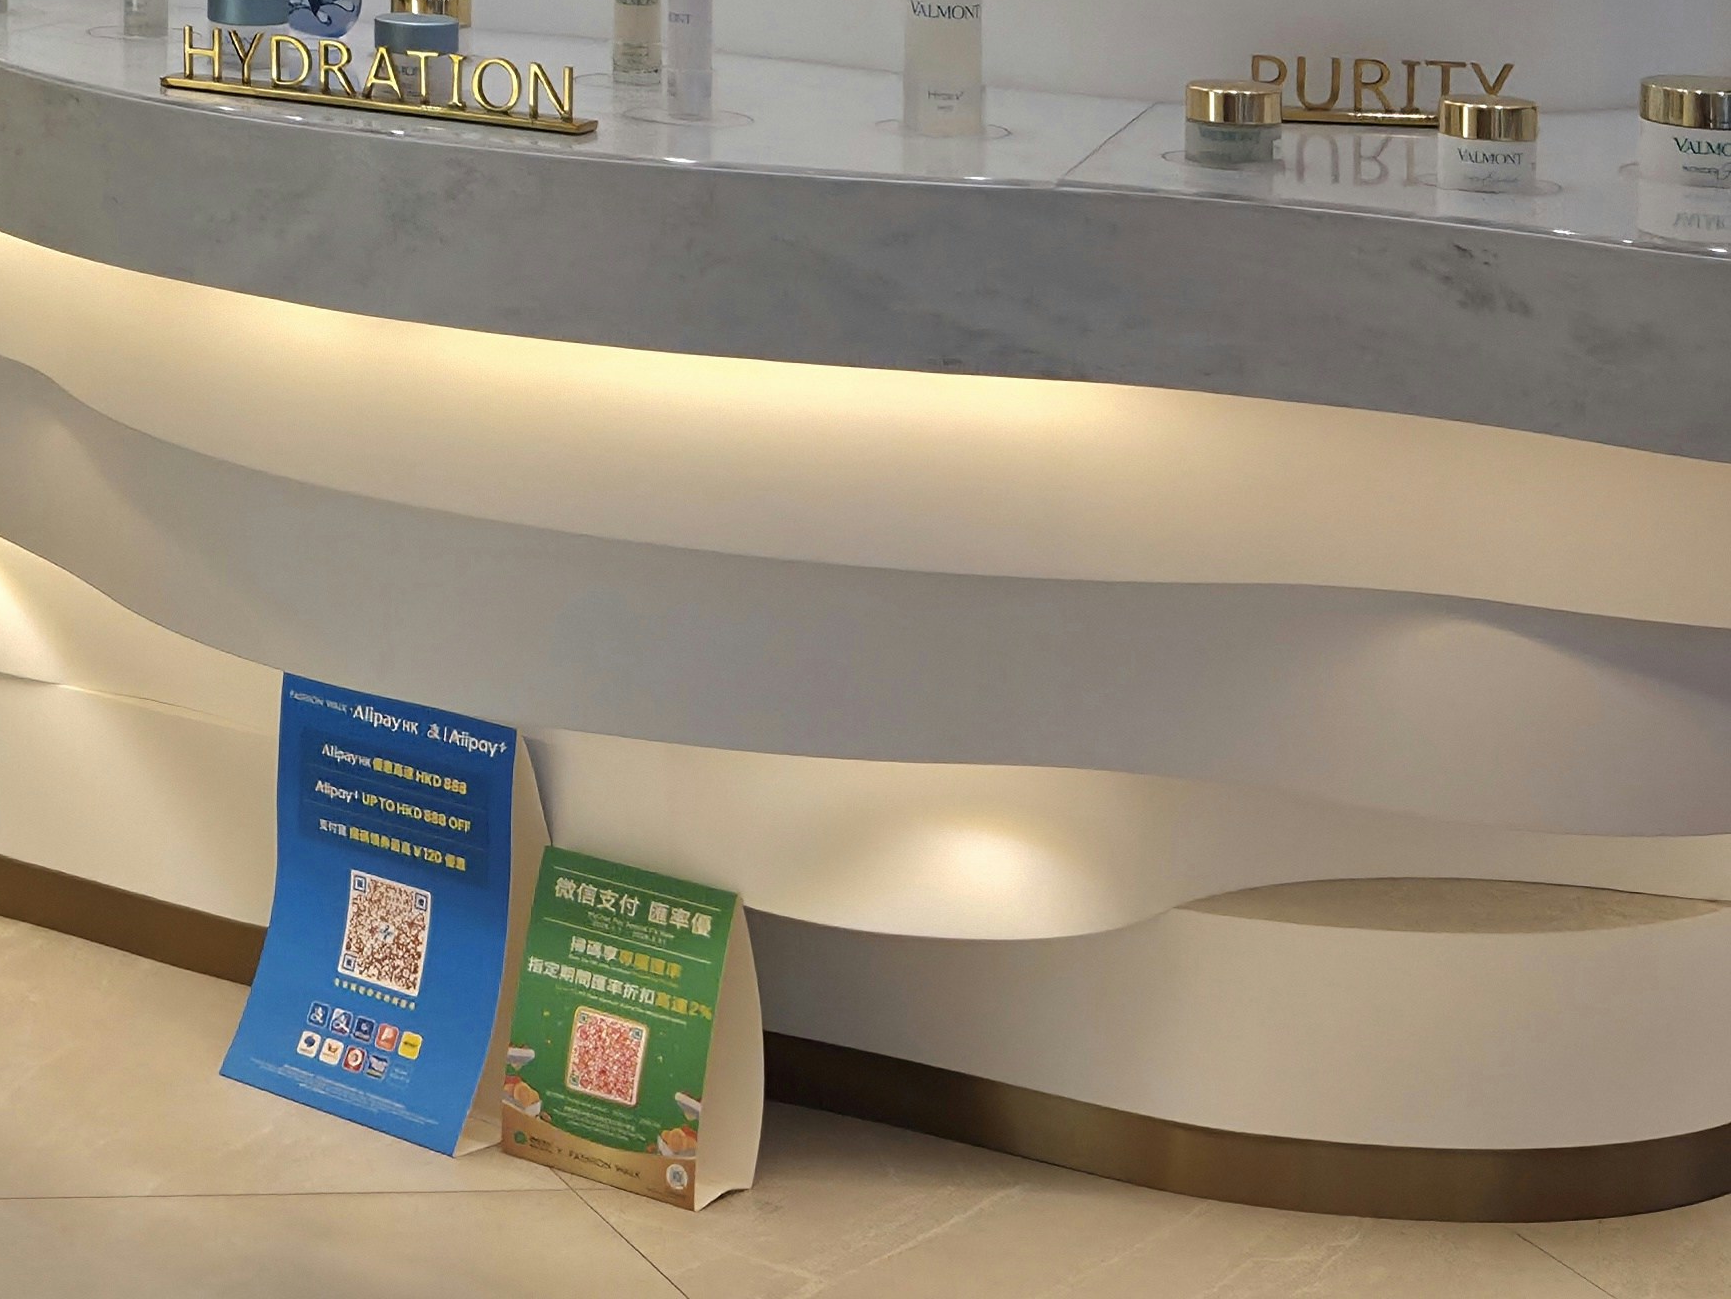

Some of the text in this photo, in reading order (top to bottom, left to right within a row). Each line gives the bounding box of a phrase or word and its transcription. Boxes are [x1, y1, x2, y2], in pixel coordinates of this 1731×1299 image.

[182, 24, 575, 124] HYDRATION
[1251, 54, 1515, 114] PURITY
[1457, 146, 1525, 167] VALMONT
[415, 769, 442, 789] HKD
[362, 791, 378, 805] UP
[379, 797, 395, 813] TO
[396, 802, 422, 820] HKD
[448, 815, 472, 833] OFF
[554, 876, 640, 918] 微信支付
